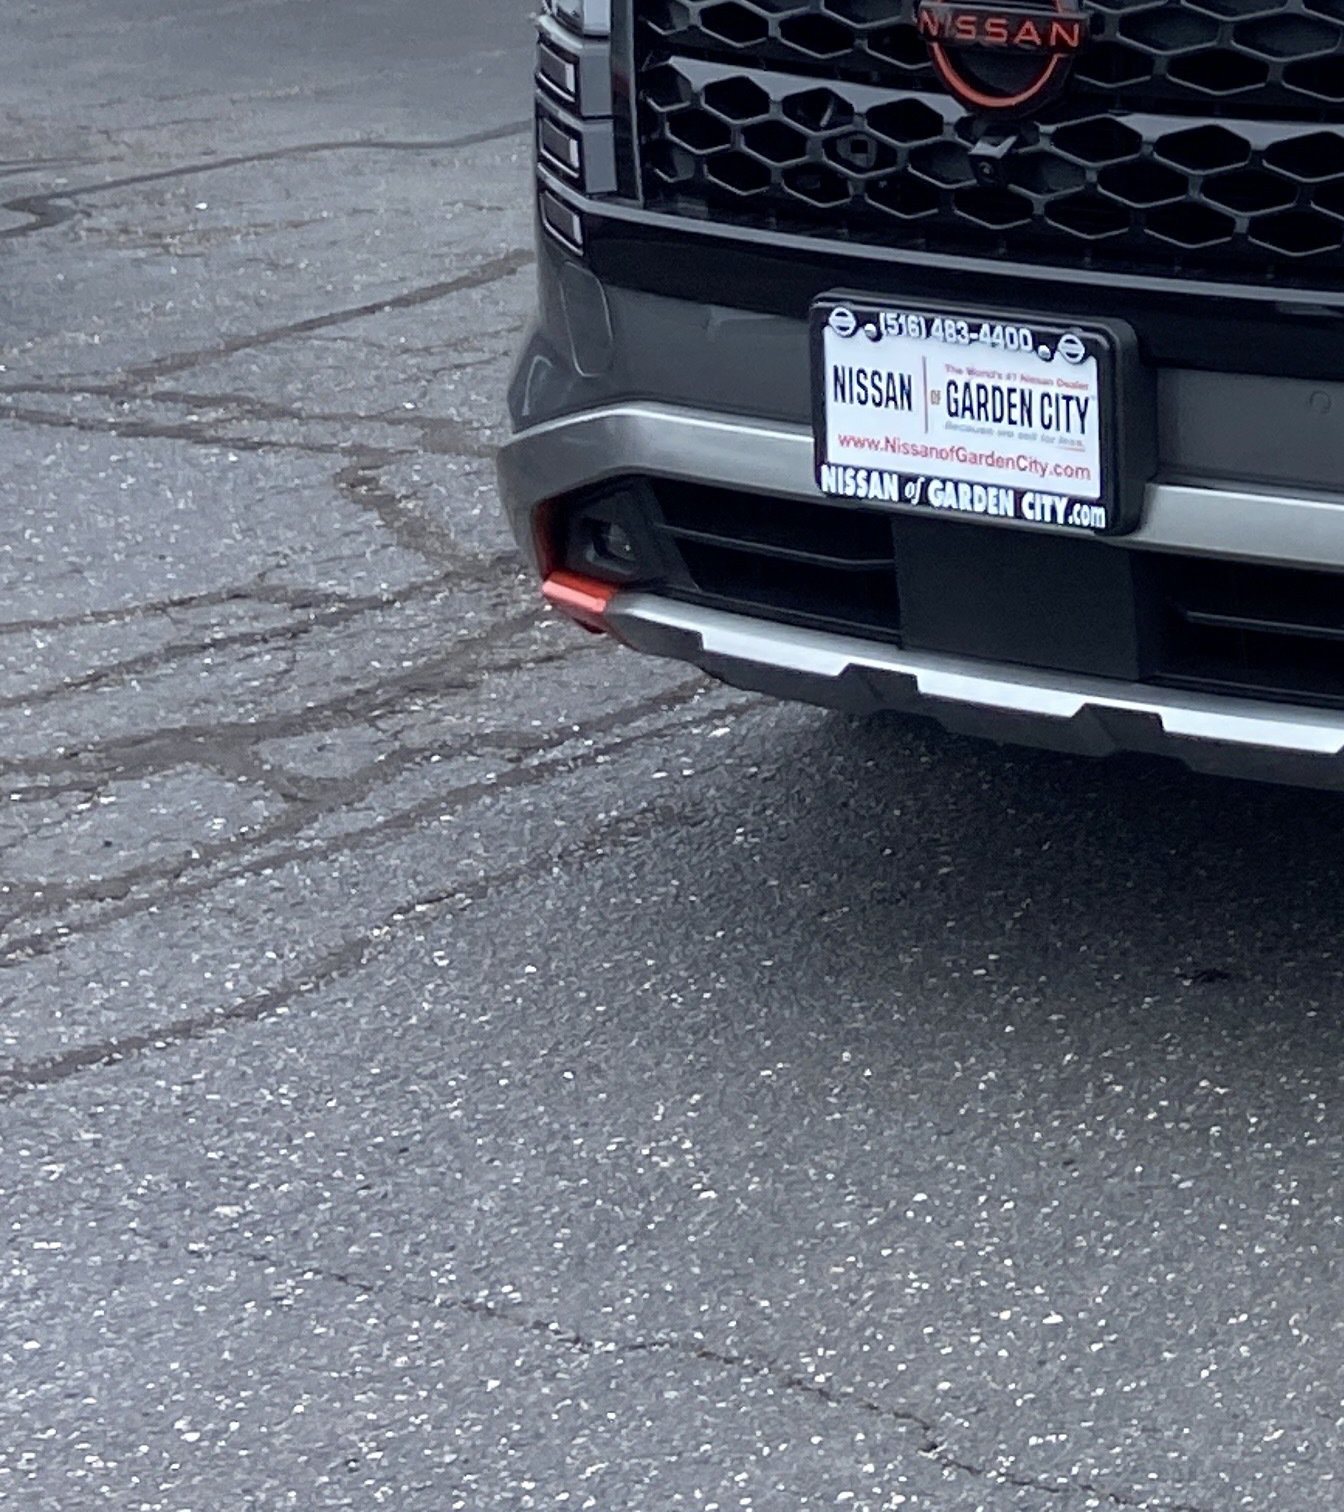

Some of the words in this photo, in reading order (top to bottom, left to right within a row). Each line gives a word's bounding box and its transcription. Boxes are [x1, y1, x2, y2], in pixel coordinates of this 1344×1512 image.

[918, 9, 1080, 48] NISSAN
[879, 312, 926, 339] (516)
[931, 317, 1034, 352] 483-4400
[833, 364, 912, 411] NISSAN
[946, 379, 1033, 428] GARDEN
[1040, 392, 1090, 435] CITY
[838, 433, 1092, 481] www.NissanofGardenCity.com
[821, 464, 899, 503] NISSAN
[904, 476, 925, 506] of
[927, 478, 1015, 517] GARDEN
[1021, 491, 1106, 528] CITY.com
